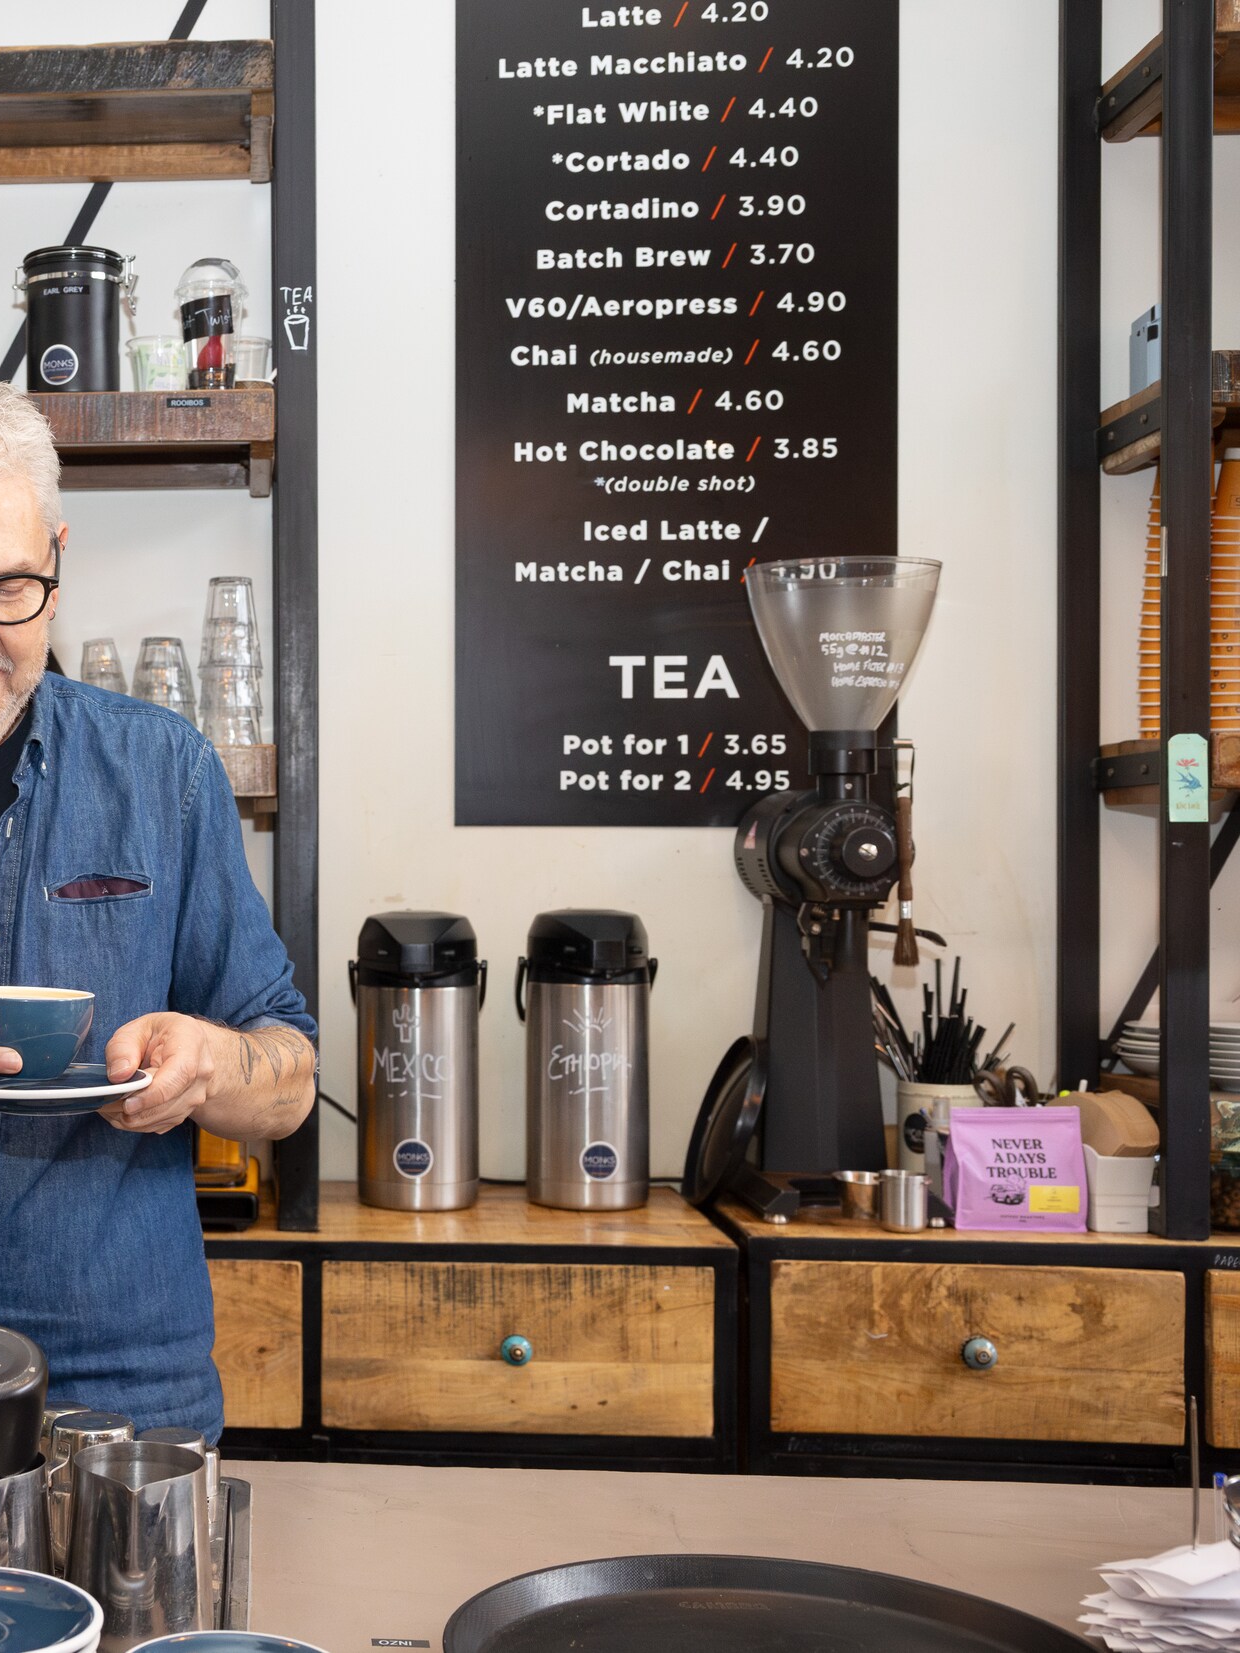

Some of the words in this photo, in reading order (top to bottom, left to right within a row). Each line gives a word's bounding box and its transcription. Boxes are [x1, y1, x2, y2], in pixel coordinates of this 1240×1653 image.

[582, 6, 661, 27] Latte
[674, 2, 688, 27] /
[701, 1, 768, 22] 4.20
[499, 58, 577, 78] Latte
[591, 51, 746, 75] Macchiato
[759, 47, 773, 72] /
[786, 47, 854, 68] 4.20
[619, 101, 709, 122] White
[721, 97, 736, 122] /
[749, 97, 818, 118] 4.40
[702, 146, 717, 171] /
[730, 146, 798, 167] 4.40
[546, 198, 699, 221] Cortadino
[711, 194, 726, 220] /
[739, 195, 805, 216] 3.90
[537, 247, 622, 269] Batch
[636, 247, 711, 267] Brew
[722, 243, 737, 268] /
[751, 243, 814, 264] 3.70
[43, 288, 60, 296] EARL
[62, 286, 84, 294] GREY
[280, 286, 313, 306] TEA
[506, 295, 737, 320] V60/Aeropress
[750, 291, 764, 316] /
[777, 291, 846, 312] 4.90
[43, 359, 74, 370] MONKS
[511, 345, 576, 366] Chai
[590, 347, 733, 366] (housemade)
[745, 339, 759, 364] /
[772, 340, 841, 361] 4.60
[171, 399, 204, 407] ROOIBOS
[567, 392, 675, 413] Matcha
[688, 389, 702, 414] /
[715, 390, 783, 410] 4.60
[515, 442, 566, 462] Hot
[580, 439, 734, 461] Chocolate
[746, 436, 761, 461] /
[774, 438, 837, 458] 3.85
[697, 476, 755, 492] shot)
[584, 520, 647, 541] Iced
[661, 521, 740, 540] Latte
[752, 517, 769, 542] /
[516, 561, 622, 582] Matcha
[634, 559, 651, 584] /
[663, 560, 729, 581] Chai
[609, 655, 739, 698] TEA
[564, 735, 612, 755] Pot
[623, 734, 667, 755] for
[677, 735, 688, 754] 1
[698, 733, 712, 757] /
[725, 734, 786, 754] 3.65
[560, 771, 609, 790] Pot
[620, 770, 663, 790] for
[674, 770, 691, 790] 2
[700, 768, 715, 793] /
[726, 770, 789, 790] 4.95
[370, 1047, 454, 1085] MEXICO
[991, 1138, 1043, 1150] NEVER
[397, 1153, 430, 1162] MONKS
[584, 1156, 616, 1165] MONKS
[994, 1152, 1004, 1164] A
[1006, 1152, 1047, 1164] DAYS
[986, 1166, 1058, 1179] TROUBLE
[1214, 1254, 1240, 1268] PAPE
